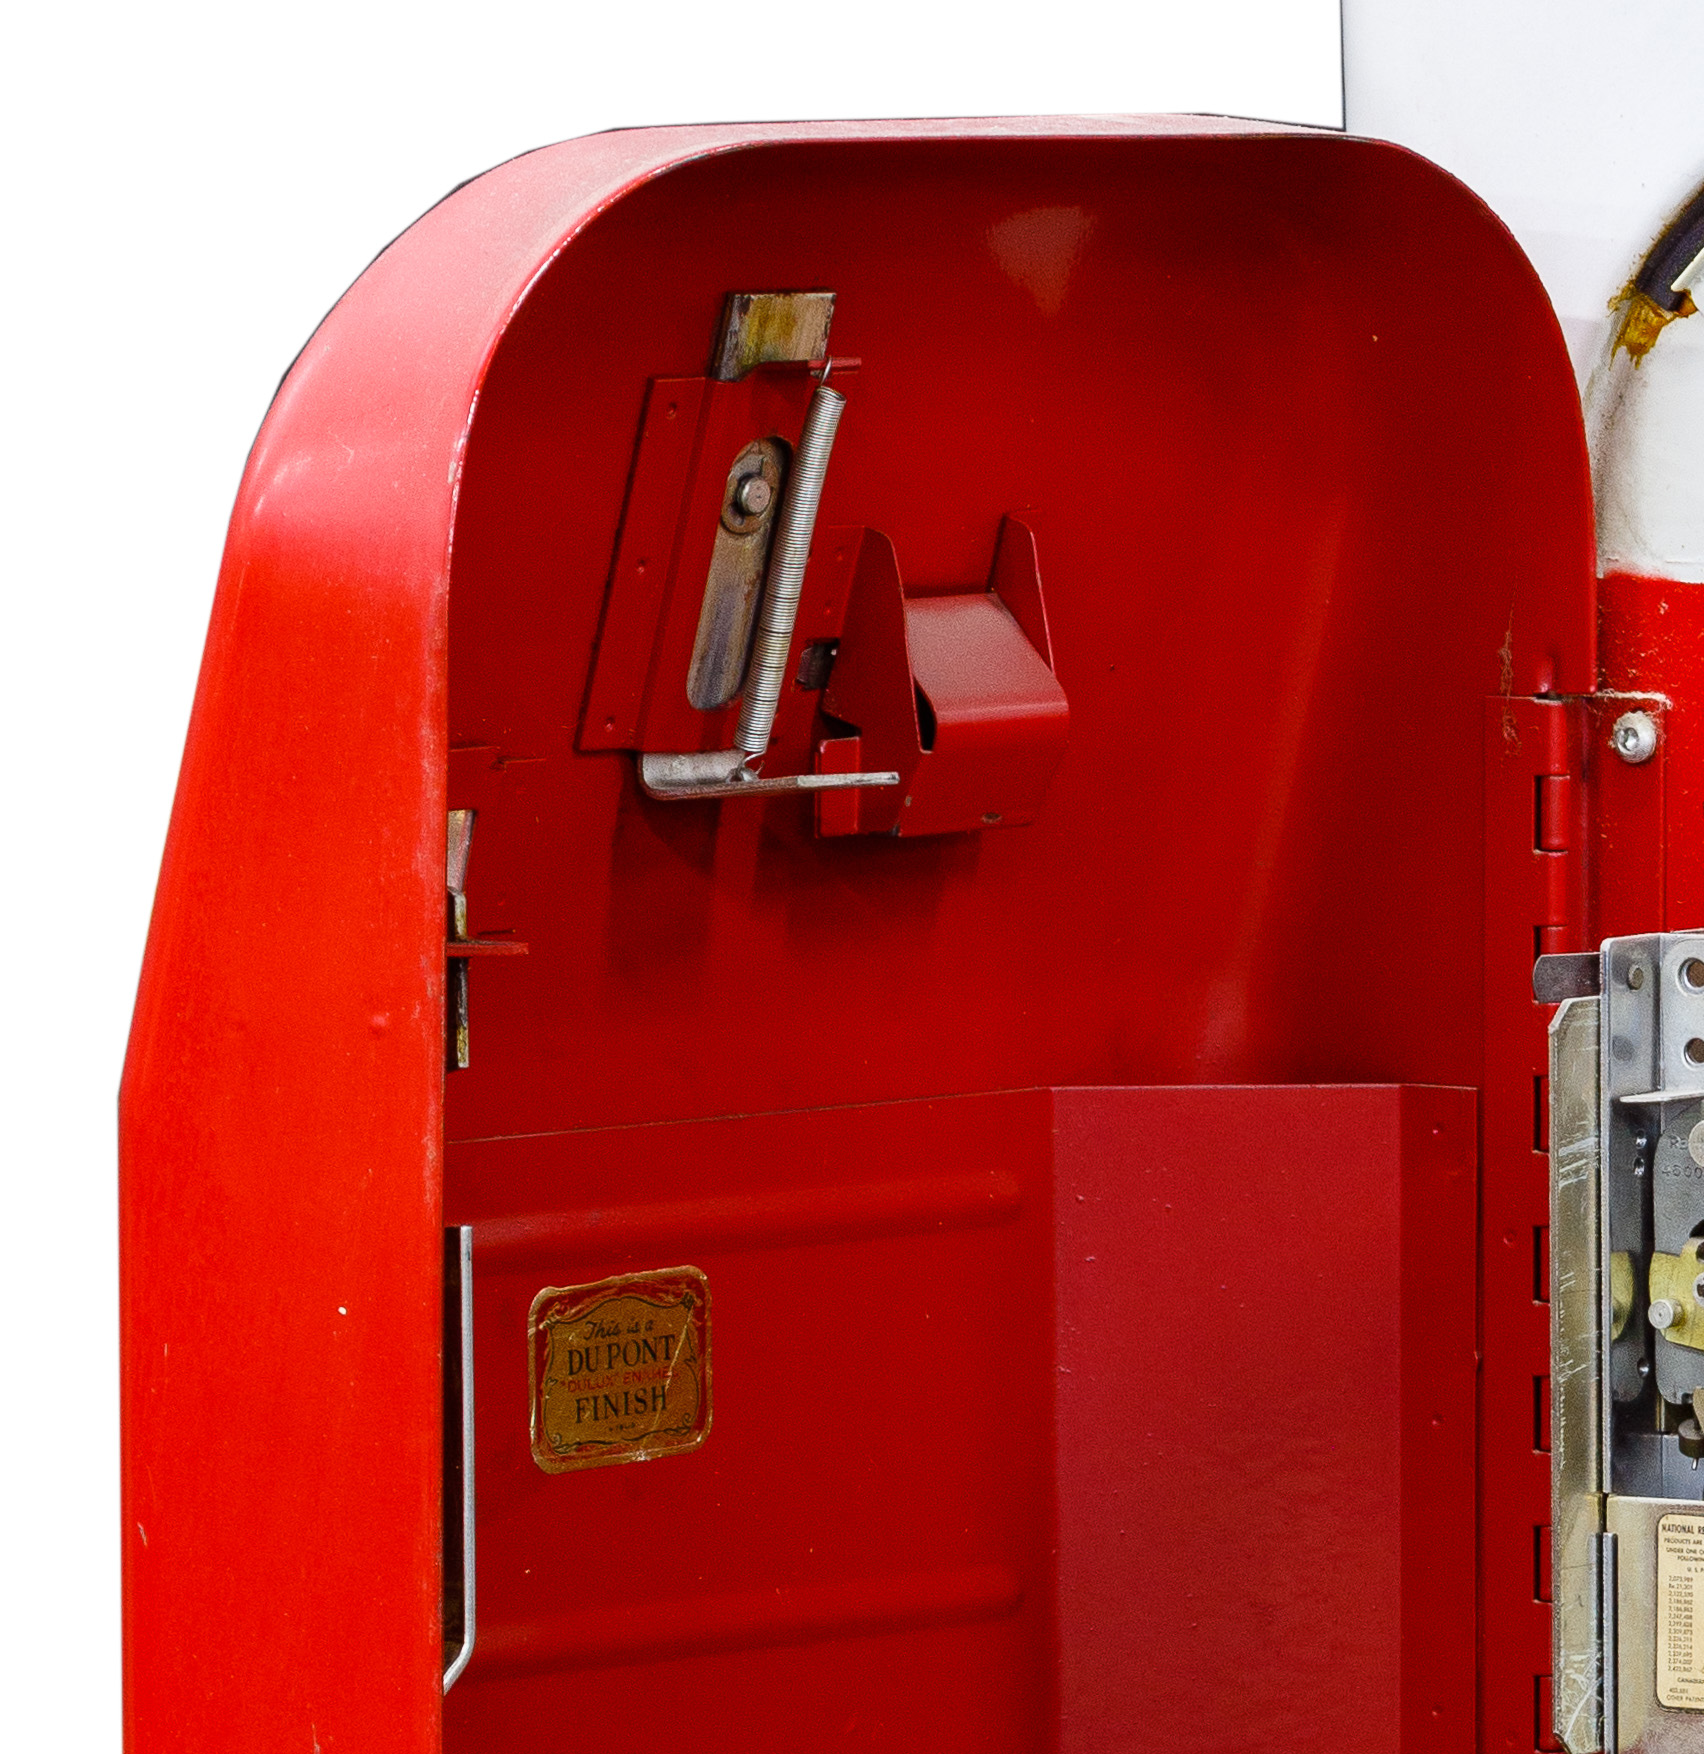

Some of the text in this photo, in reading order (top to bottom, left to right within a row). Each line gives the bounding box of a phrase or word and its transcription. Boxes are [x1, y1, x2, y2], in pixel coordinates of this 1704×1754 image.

[584, 1319, 621, 1340] This
[575, 1385, 666, 1423] FINISH
[1661, 1524, 1694, 1534] NATIONAL
